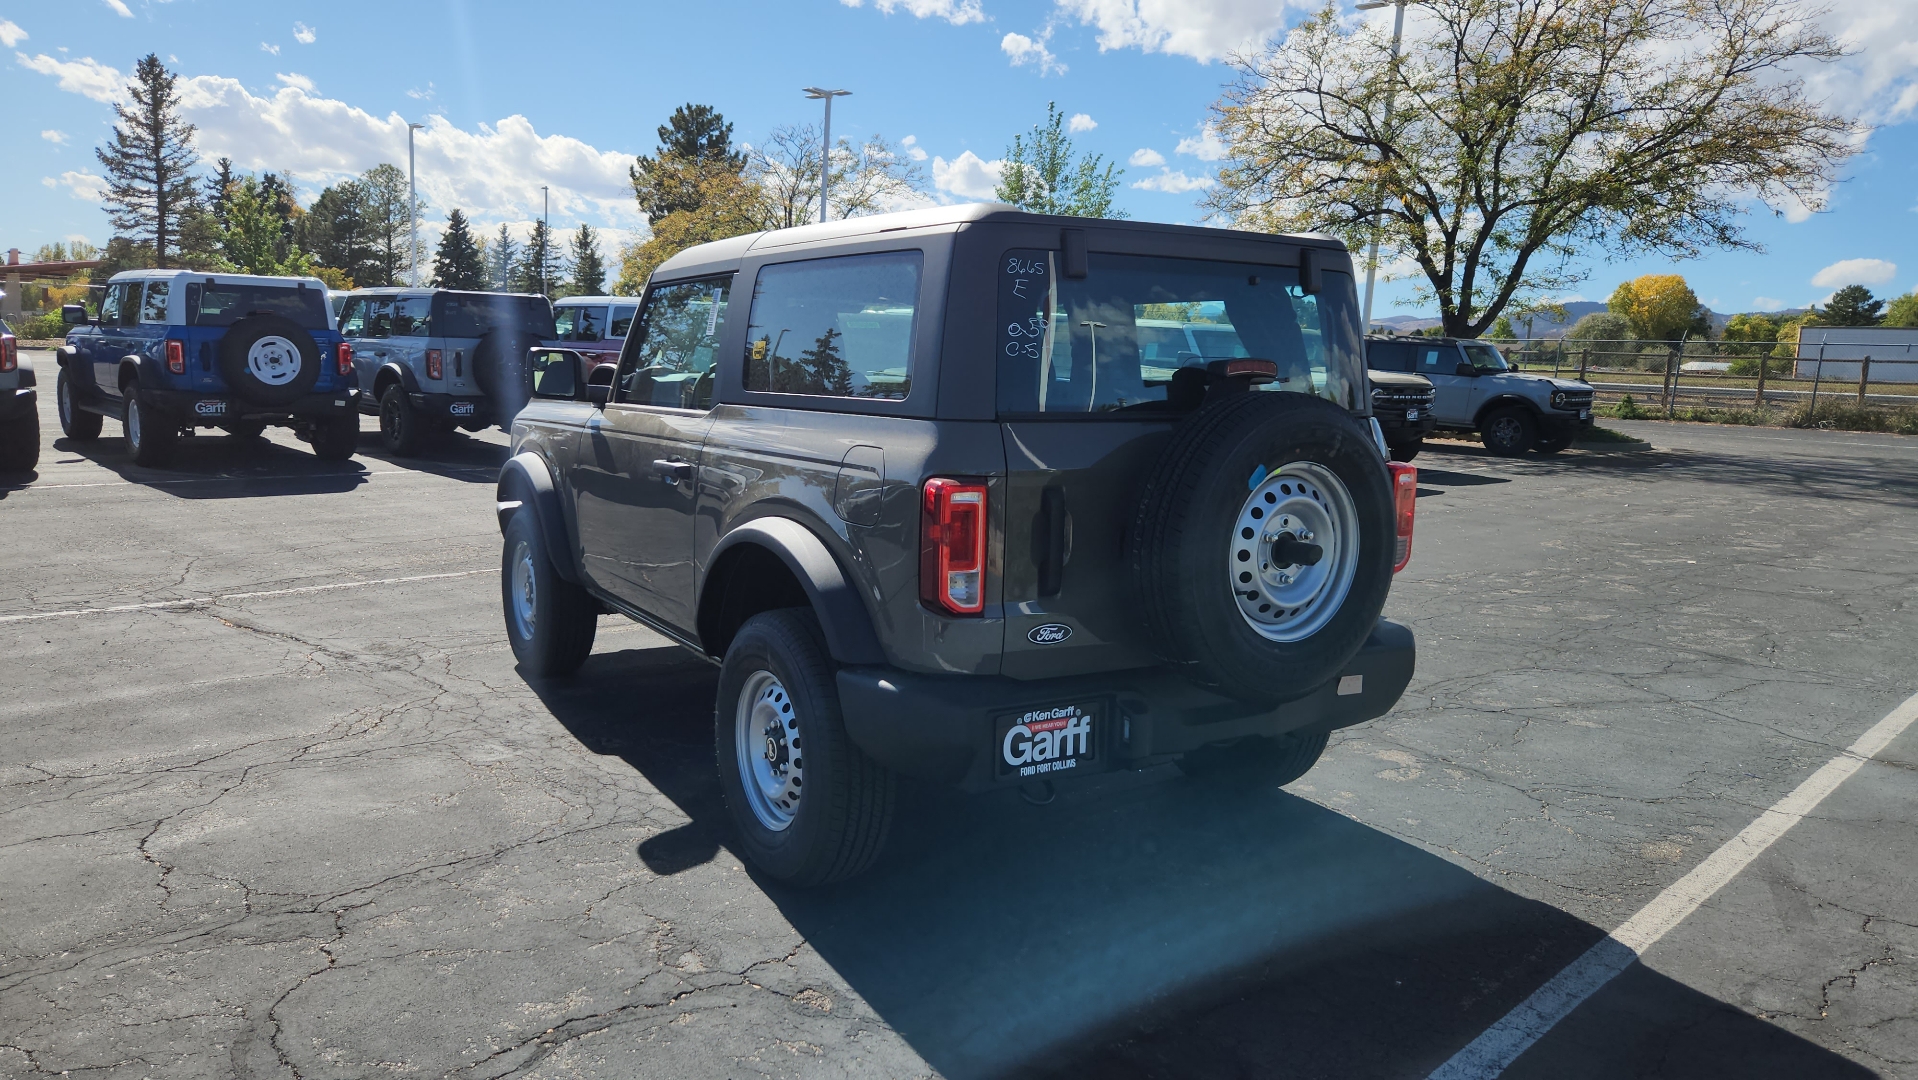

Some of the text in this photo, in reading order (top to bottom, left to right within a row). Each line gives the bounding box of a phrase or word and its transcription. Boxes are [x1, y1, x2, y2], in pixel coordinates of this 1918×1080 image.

[1007, 257, 1045, 275] 8665
[195, 402, 227, 414] Garff
[449, 404, 475, 414] Garff
[1032, 705, 1075, 722] Ken Garff
[1003, 715, 1091, 766] Garff
[1020, 758, 1077, 777] FORD FORT COLLINS
